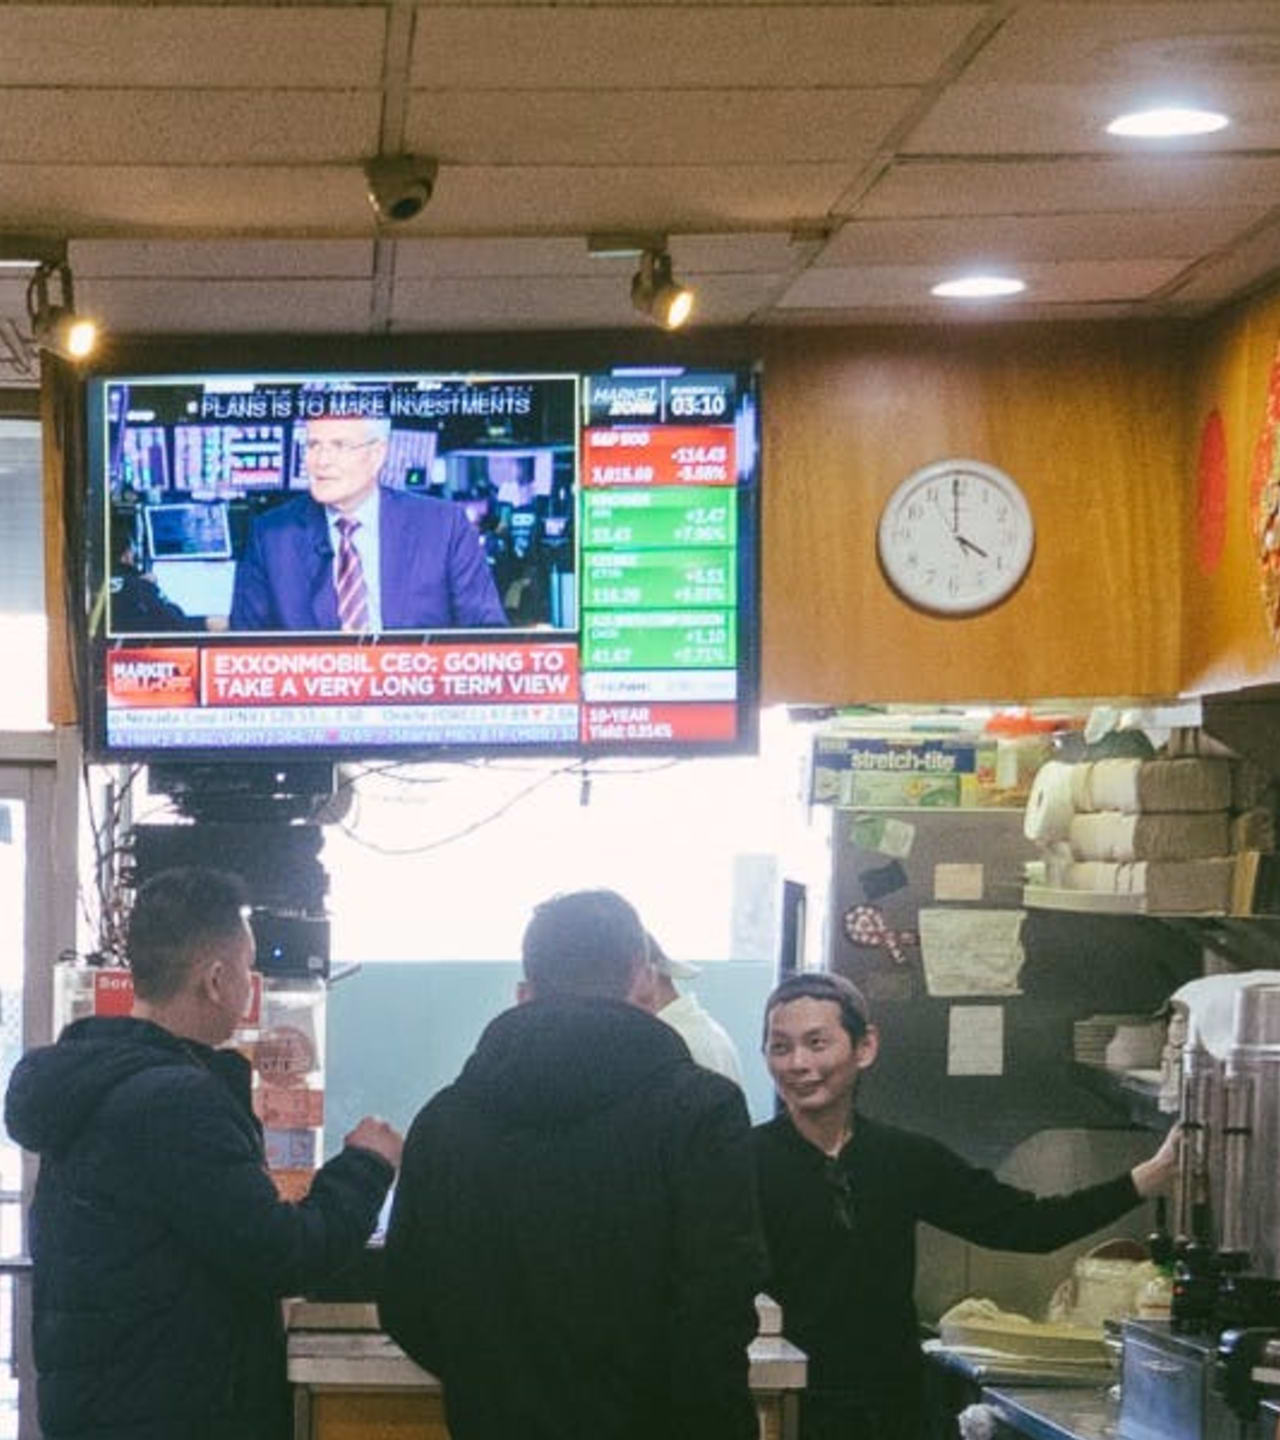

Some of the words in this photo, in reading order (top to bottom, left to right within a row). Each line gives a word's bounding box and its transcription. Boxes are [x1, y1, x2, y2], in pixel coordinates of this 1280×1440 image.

[594, 387, 657, 402] MARKET
[201, 402, 267, 419] PLANS
[272, 401, 291, 418] IS
[299, 401, 325, 418] TO
[330, 399, 385, 417] MAKE
[391, 397, 531, 416] INVESTMENTS
[671, 396, 726, 415] 03:10
[113, 662, 175, 679] MARKET
[214, 654, 374, 674] EXXONMOBIL
[380, 652, 438, 673] CEO:
[443, 651, 523, 672] GOING
[530, 650, 564, 671] TO
[214, 677, 276, 698] TAKE
[280, 677, 298, 697] A
[303, 676, 364, 697] VERY
[369, 675, 436, 697] LONG
[440, 675, 504, 695] TERM
[506, 674, 569, 695] VIEW
